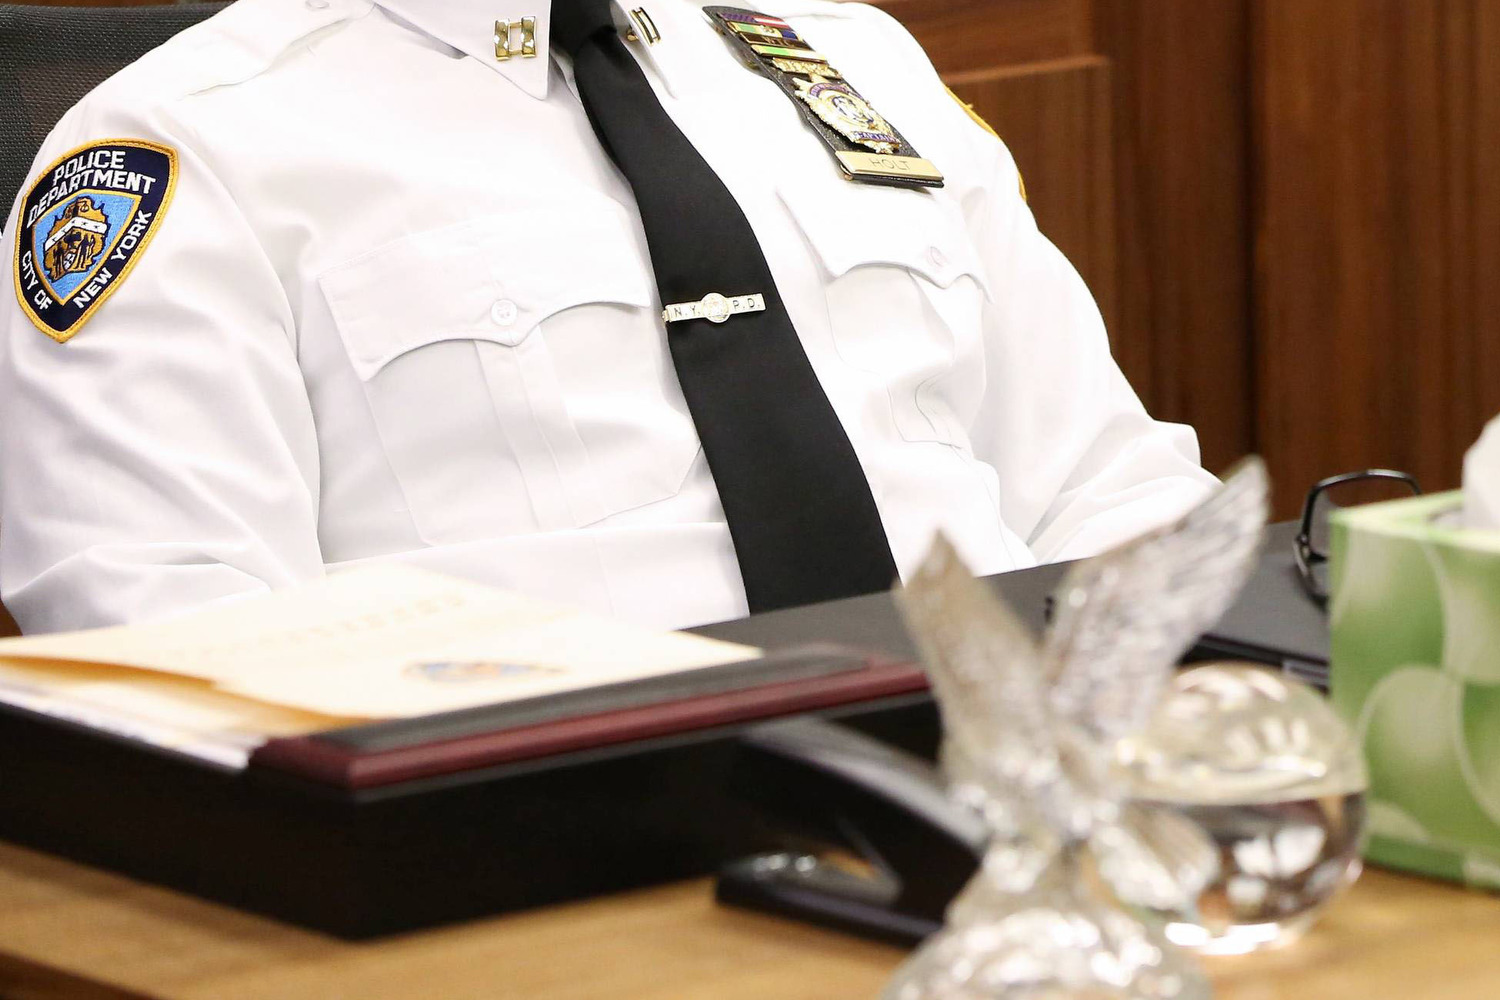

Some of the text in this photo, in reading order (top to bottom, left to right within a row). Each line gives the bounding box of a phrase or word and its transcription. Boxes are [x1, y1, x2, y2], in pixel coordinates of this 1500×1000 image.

[52, 150, 126, 186] POLICE
[869, 159, 910, 170] HOLT
[27, 169, 156, 228] DEPARTMENT
[22, 210, 152, 310] CITY OF NEW YORK
